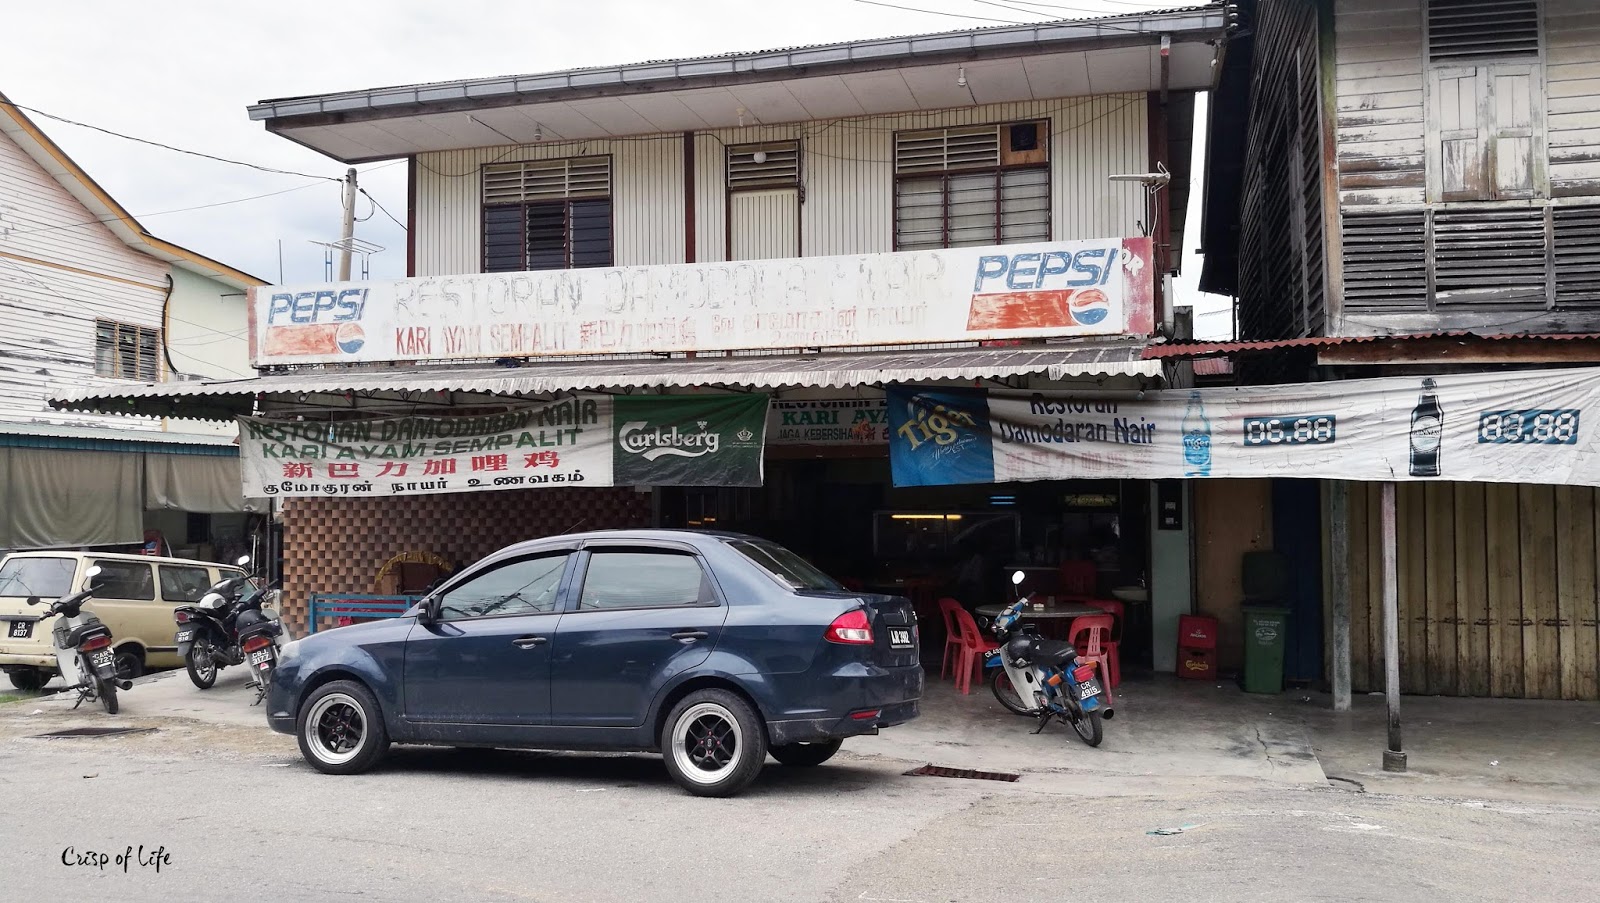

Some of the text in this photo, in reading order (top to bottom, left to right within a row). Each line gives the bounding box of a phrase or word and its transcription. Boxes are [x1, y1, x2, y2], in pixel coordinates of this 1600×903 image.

[975, 247, 1119, 292] PEPSI
[268, 288, 369, 324] PEPSI
[396, 326, 432, 355] KARI
[538, 399, 598, 427] NAIR
[782, 410, 839, 425] KARI
[898, 405, 977, 450] Tiger
[336, 443, 427, 459] AYAM
[433, 429, 583, 456] SEMPALIT
[619, 421, 720, 459] Carlsberg
[1114, 417, 1156, 444] Nair
[1185, 438, 1209, 450] Tiger
[282, 450, 561, 479] 新巴力加哩鸡
[1080, 681, 1091, 690] CR
[1081, 686, 1098, 698] 4915
